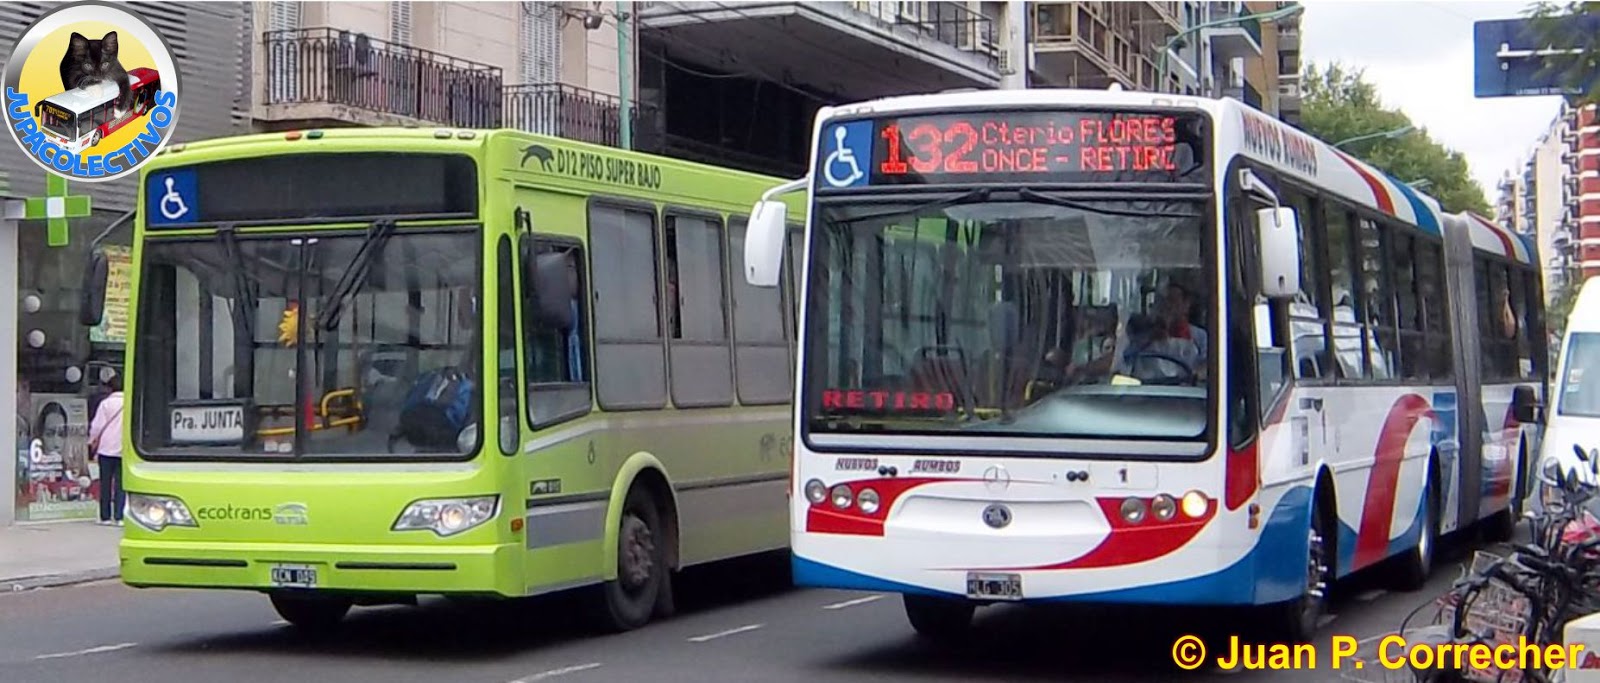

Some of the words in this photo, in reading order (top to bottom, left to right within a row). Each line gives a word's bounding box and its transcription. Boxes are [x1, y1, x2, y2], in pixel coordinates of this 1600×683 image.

[880, 121, 978, 174] 132
[982, 120, 1075, 145] Cterio
[1080, 117, 1175, 143] FLORES
[557, 148, 577, 176] D12
[580, 152, 603, 180] PISO
[606, 157, 635, 185] SUPER
[638, 162, 661, 189] BAJO
[982, 148, 1048, 172] ONCE
[823, 390, 954, 411] RETIRO
[174, 411, 197, 429] Pra.
[201, 410, 243, 429] JUNTA
[835, 458, 878, 471] NUEVOS
[1119, 468, 1127, 483] 1
[198, 503, 272, 520] ecotrans
